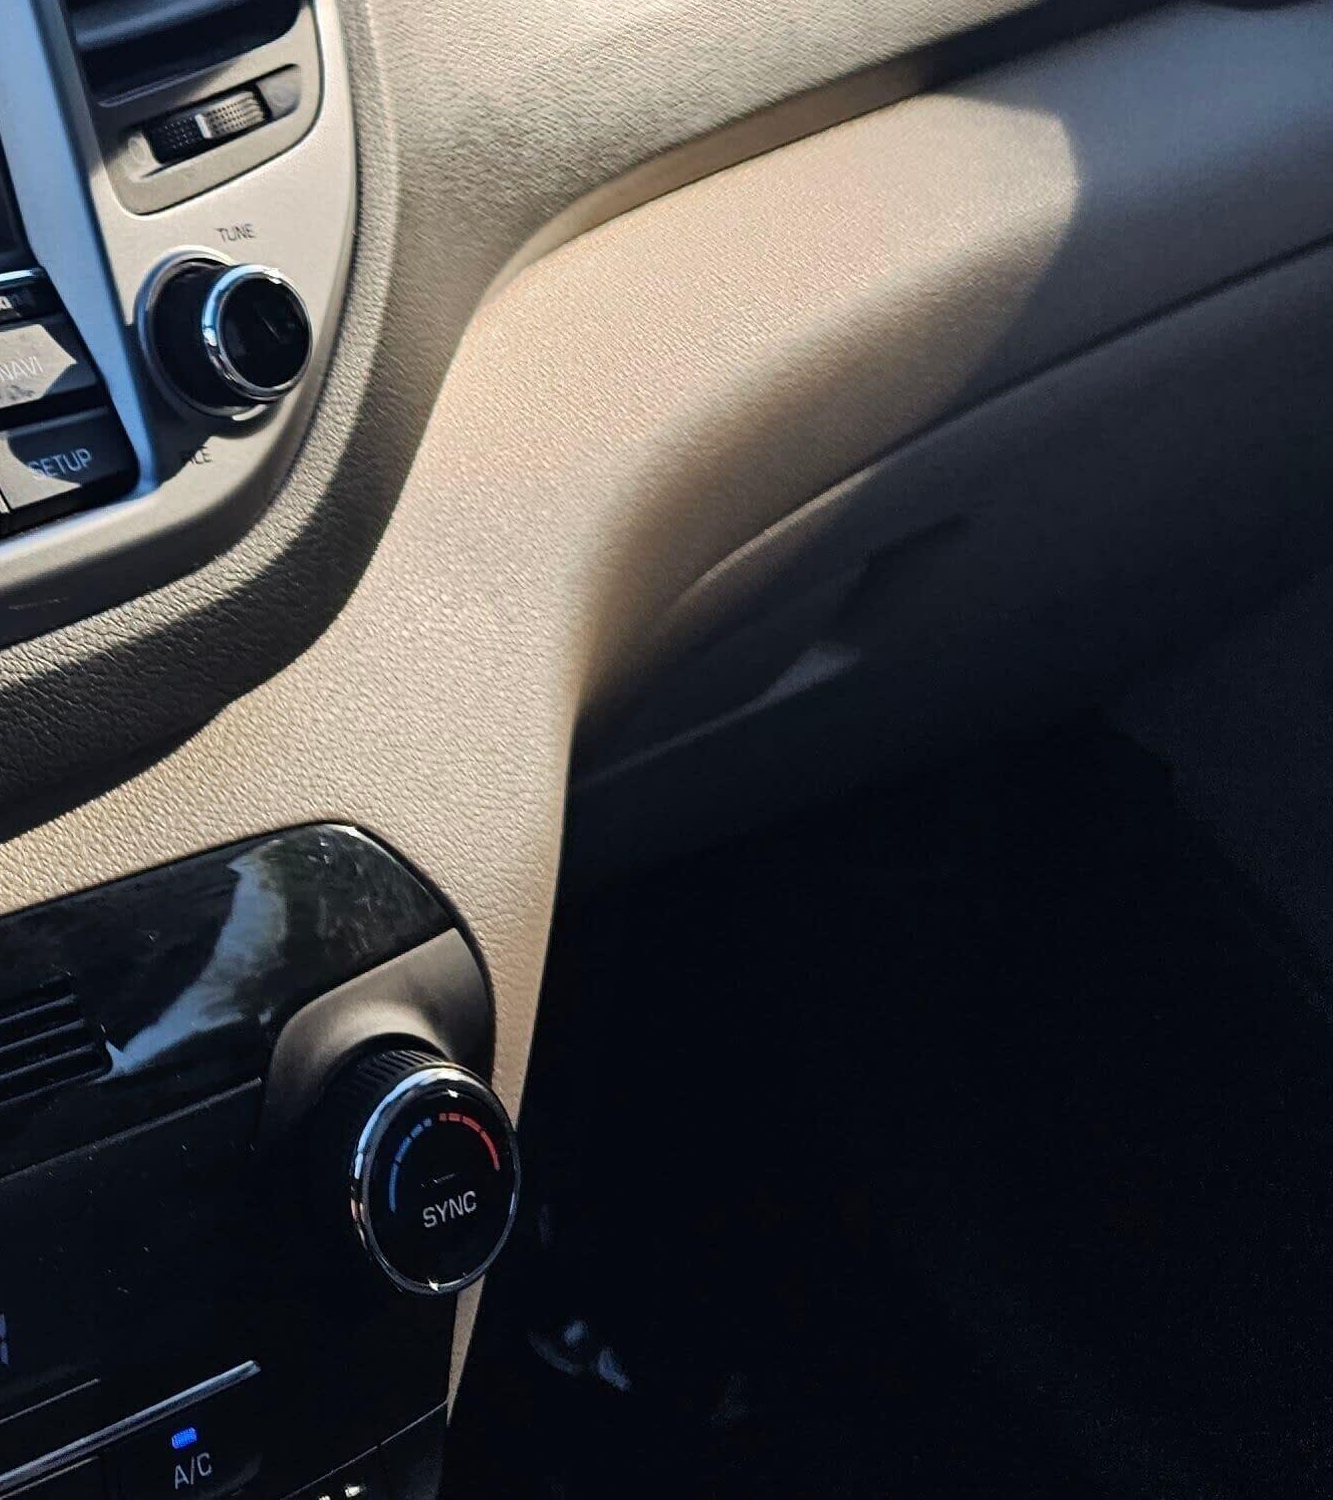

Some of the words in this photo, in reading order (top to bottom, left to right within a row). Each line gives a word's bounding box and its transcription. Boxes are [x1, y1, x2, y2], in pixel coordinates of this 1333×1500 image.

[213, 223, 255, 242] TUNE
[30, 448, 93, 478] SETUP
[422, 1190, 477, 1228] SYNC
[172, 1451, 214, 1490] A/C
